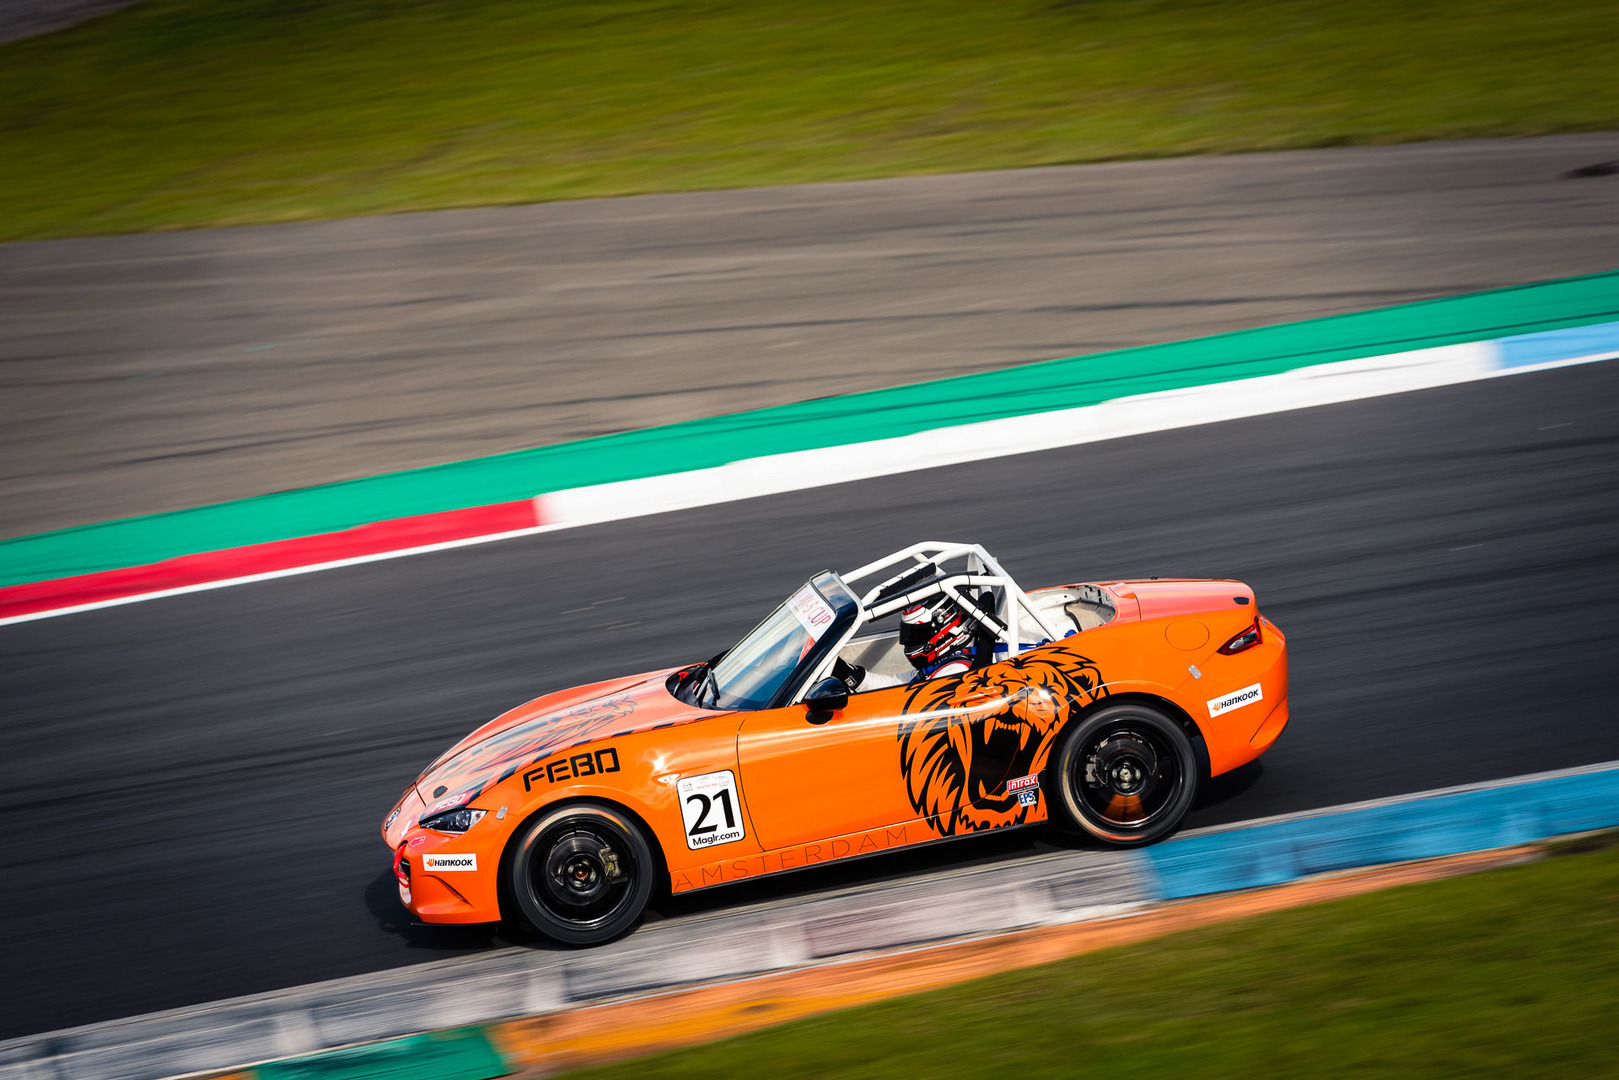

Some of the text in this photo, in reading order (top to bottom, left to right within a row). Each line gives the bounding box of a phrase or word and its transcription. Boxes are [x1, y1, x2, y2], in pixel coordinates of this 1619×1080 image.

[807, 607, 832, 627] CUP
[523, 747, 621, 792] FEBO
[686, 788, 736, 837] 21
[674, 826, 908, 892] AMSTERDAM
[692, 831, 740, 847] Maglr.com
